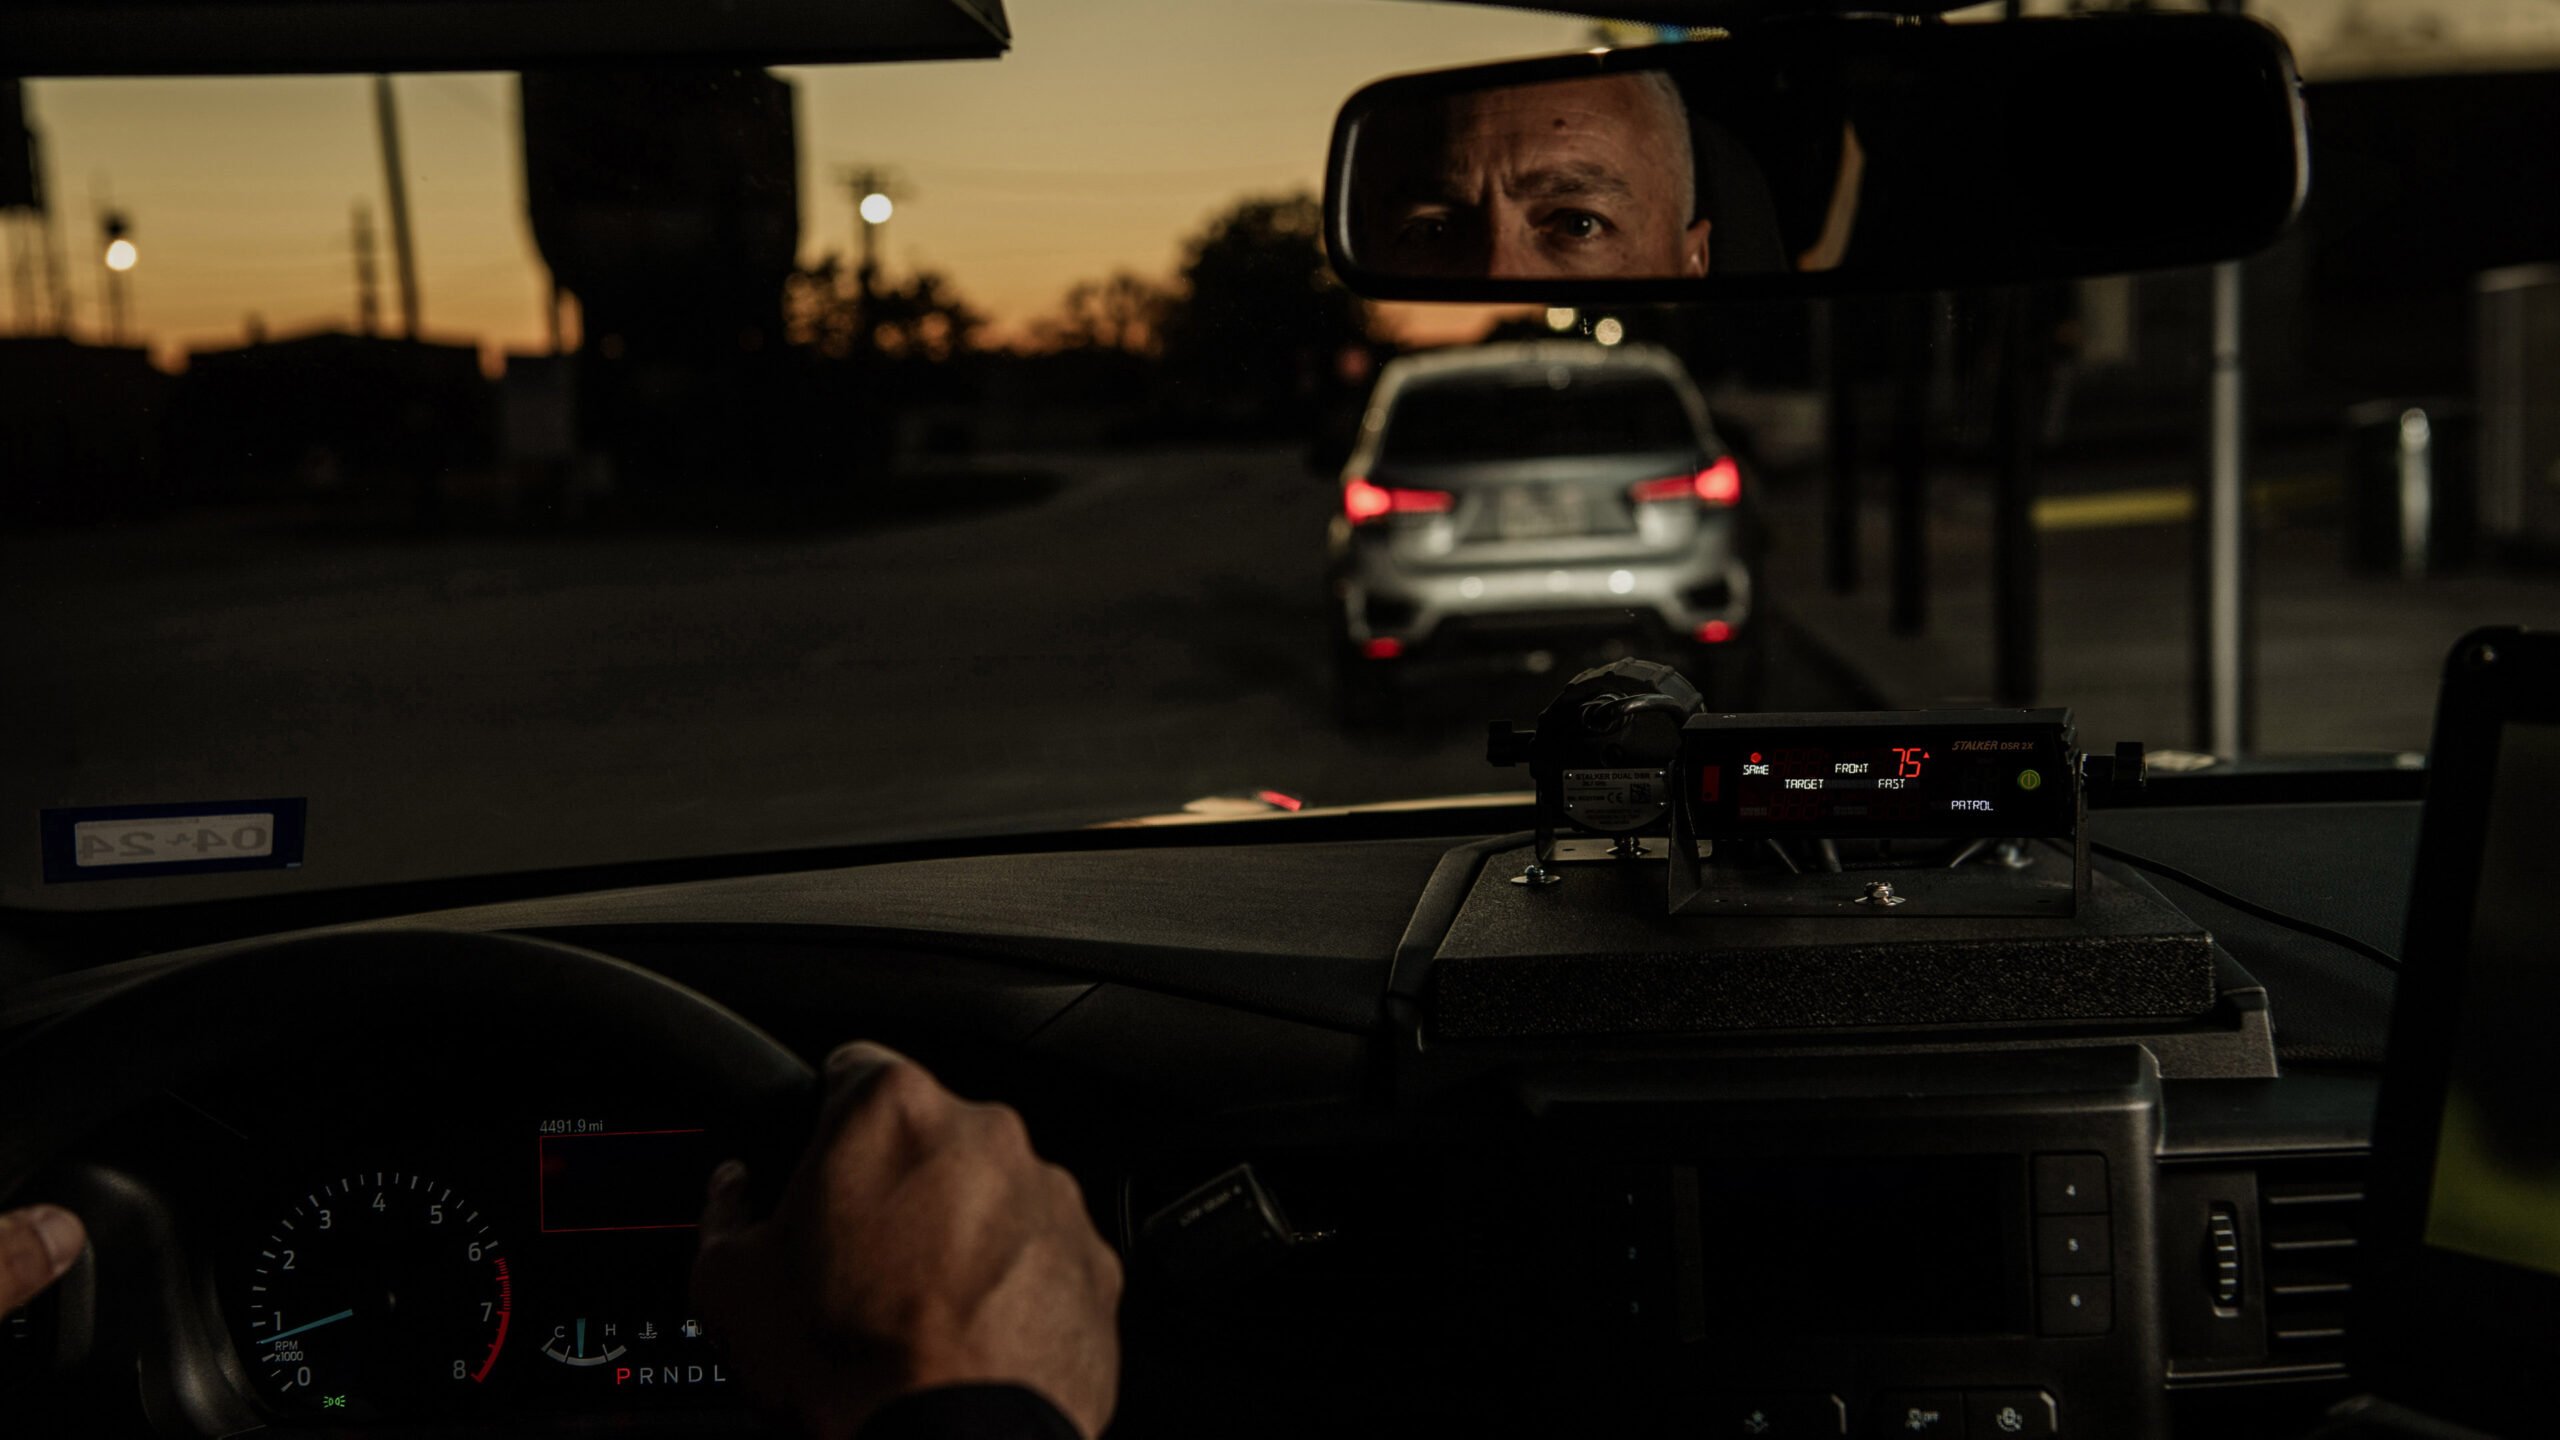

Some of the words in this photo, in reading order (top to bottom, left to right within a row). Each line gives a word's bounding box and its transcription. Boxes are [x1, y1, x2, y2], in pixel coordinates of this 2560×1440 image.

[1951, 740, 1999, 751] STALKER
[2000, 742, 2020, 750] DSR
[2021, 742, 2034, 750] 2X
[1742, 764, 1769, 776] SAME
[1834, 763, 1869, 774] FRONT
[1892, 748, 1921, 778] 75
[1784, 778, 1824, 790] TARGET
[1878, 778, 1906, 790] FAST
[1951, 800, 1994, 812] PATROL
[539, 1119, 586, 1135] 4491.9
[588, 1120, 604, 1133] mi
[372, 1192, 387, 1213] 4
[319, 1209, 332, 1230] 3
[430, 1204, 444, 1225] 5
[282, 1250, 296, 1271] 2
[467, 1242, 482, 1262] 6
[273, 1310, 281, 1331] 1
[480, 1302, 493, 1323] 7
[553, 1325, 566, 1340] C
[605, 1323, 617, 1336] H
[274, 1341, 299, 1351] RPM
[297, 1366, 311, 1387] 0
[452, 1360, 467, 1380] 8
[616, 1367, 631, 1385] P
[639, 1367, 655, 1384] R
[664, 1366, 679, 1384] N
[688, 1366, 703, 1383] D
[714, 1364, 727, 1383] L
